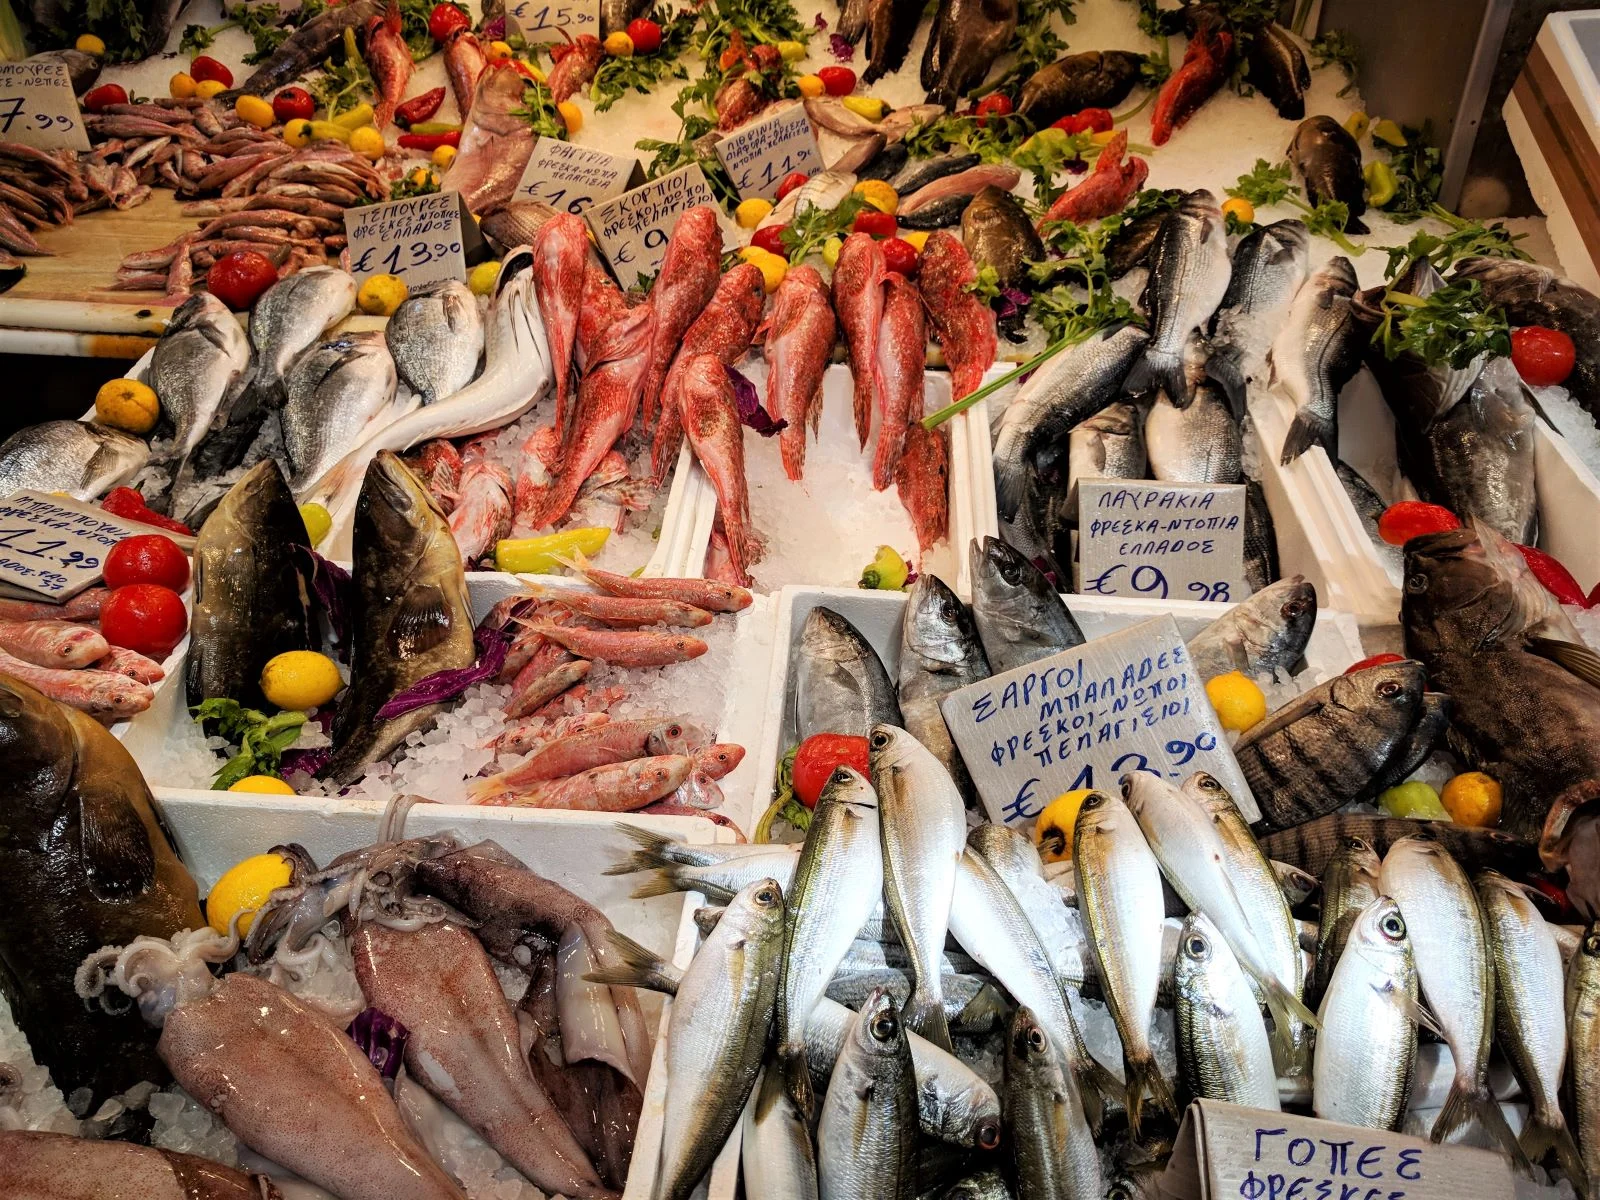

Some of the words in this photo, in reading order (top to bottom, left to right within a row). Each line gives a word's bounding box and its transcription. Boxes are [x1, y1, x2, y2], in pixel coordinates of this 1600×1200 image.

[1098, 489, 1215, 511] ΛΑΥΡΑΚΙΑ
[1119, 539, 1215, 556] ΕΛΛΑΔΟΣ
[972, 658, 1083, 724] ΣΑΡΓΟΙ
[1040, 646, 1186, 722] ΜΠΑΛΑΔΕΣ
[1033, 697, 1190, 768] ΠΕΛΑΓΙΣΙΟΙ
[1255, 1128, 1423, 1180] ΓΟΠΕΣ
